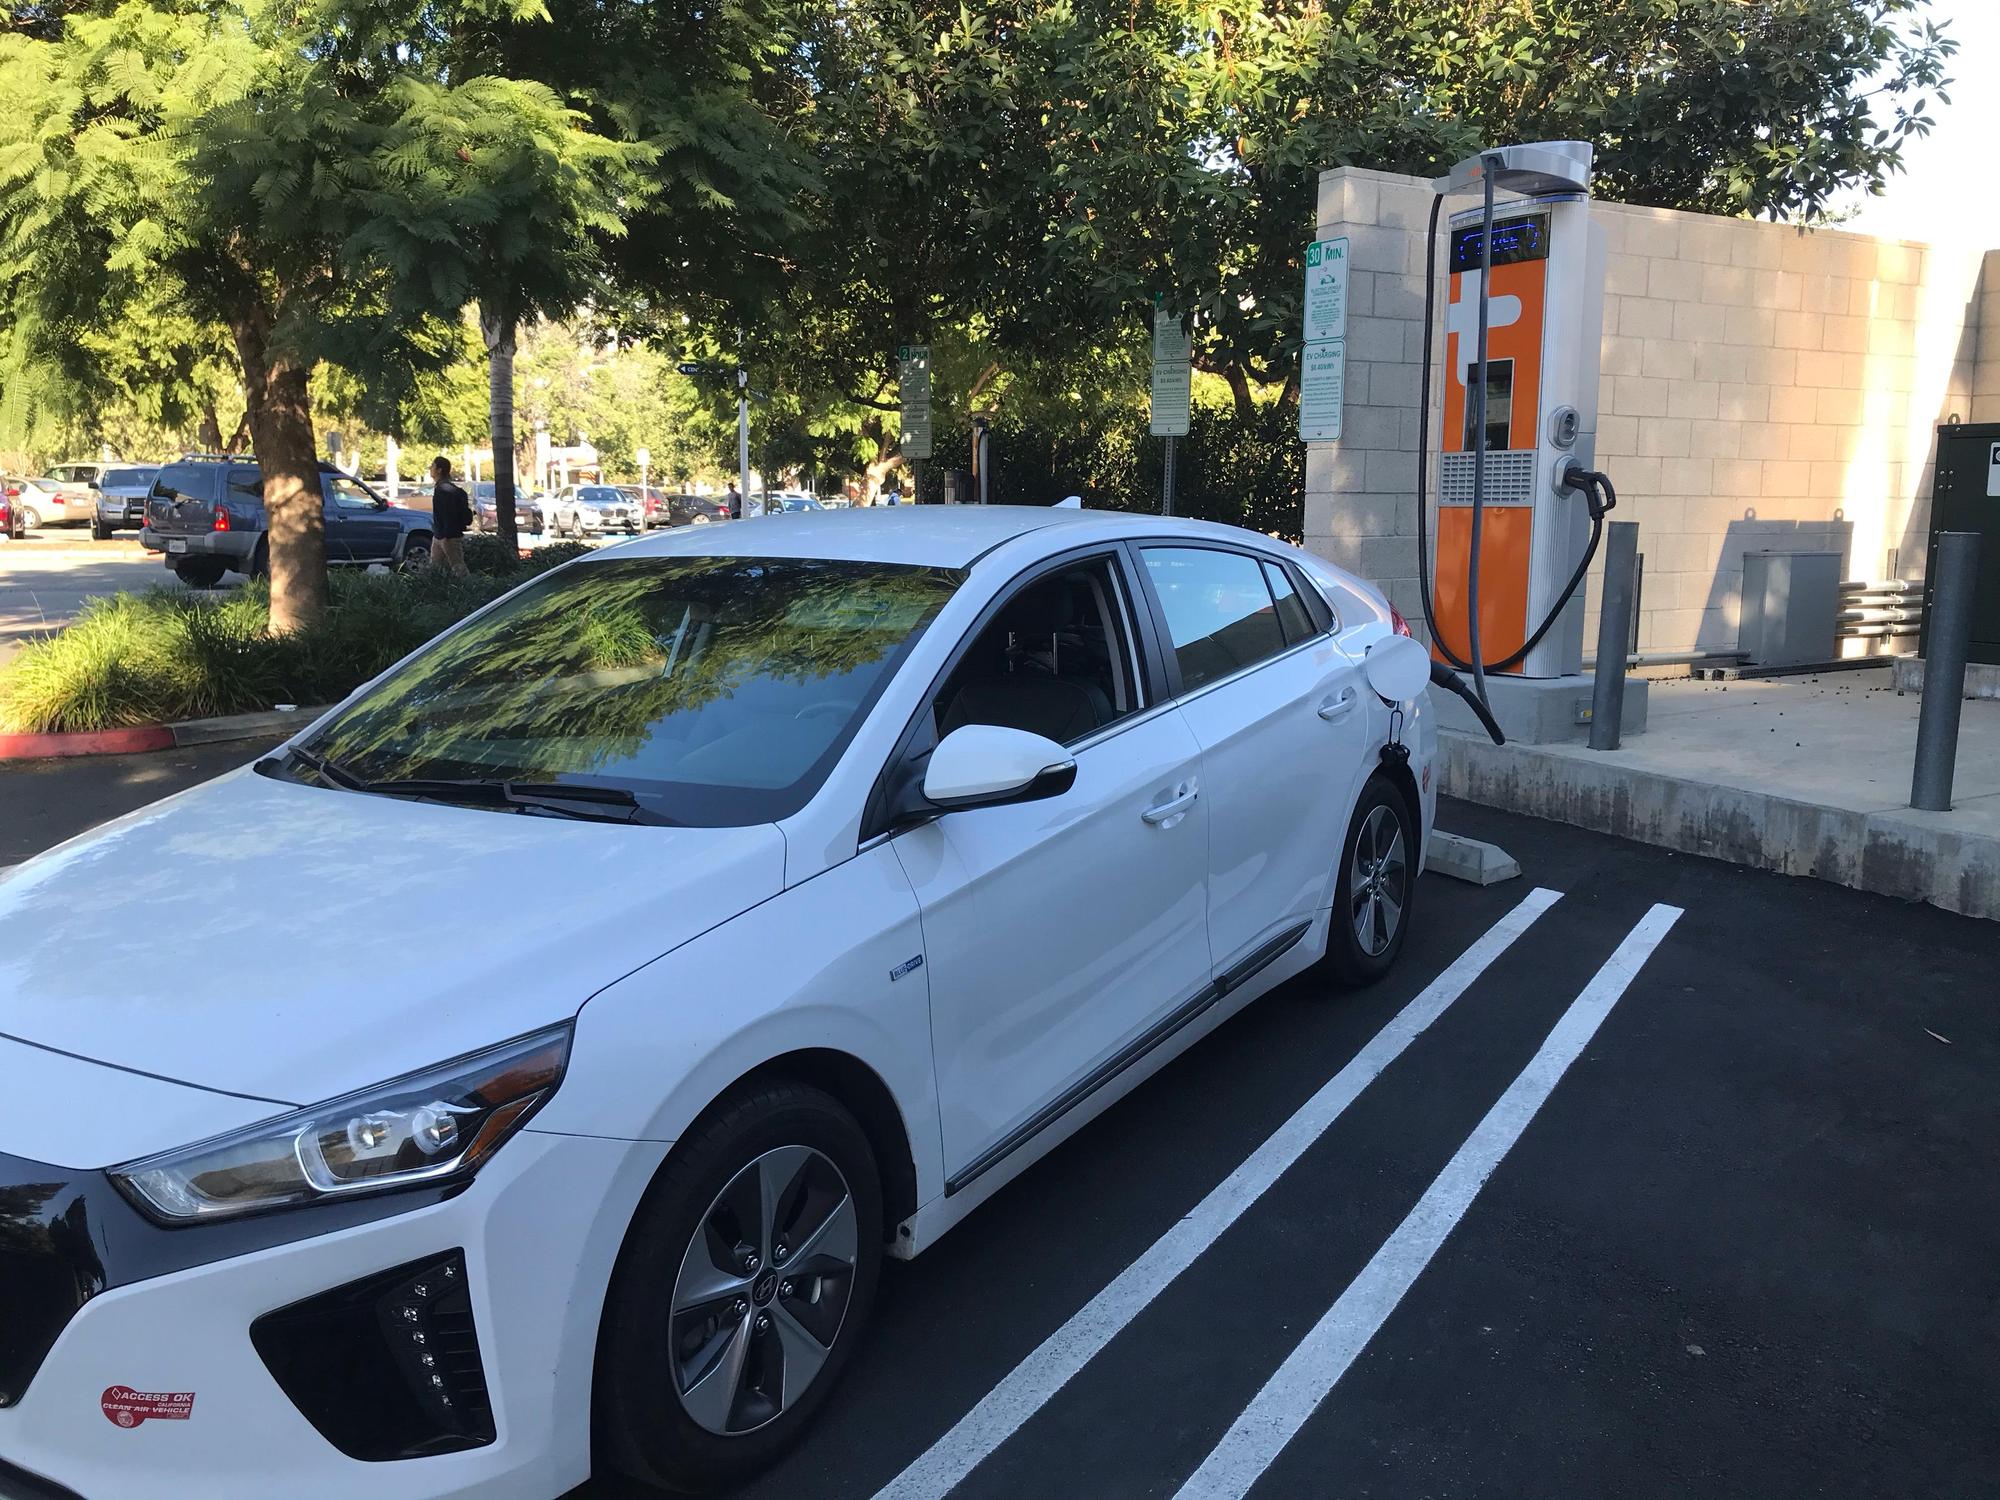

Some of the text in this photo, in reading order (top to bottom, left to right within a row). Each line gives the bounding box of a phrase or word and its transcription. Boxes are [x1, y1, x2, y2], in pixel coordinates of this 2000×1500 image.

[1310, 247, 1344, 264] 30 MIN.
[902, 348, 908, 360] 2
[1314, 351, 1340, 360] CHARGING
[121, 1392, 192, 1402] ACCESS OK
[103, 1403, 132, 1411] CLEAN
